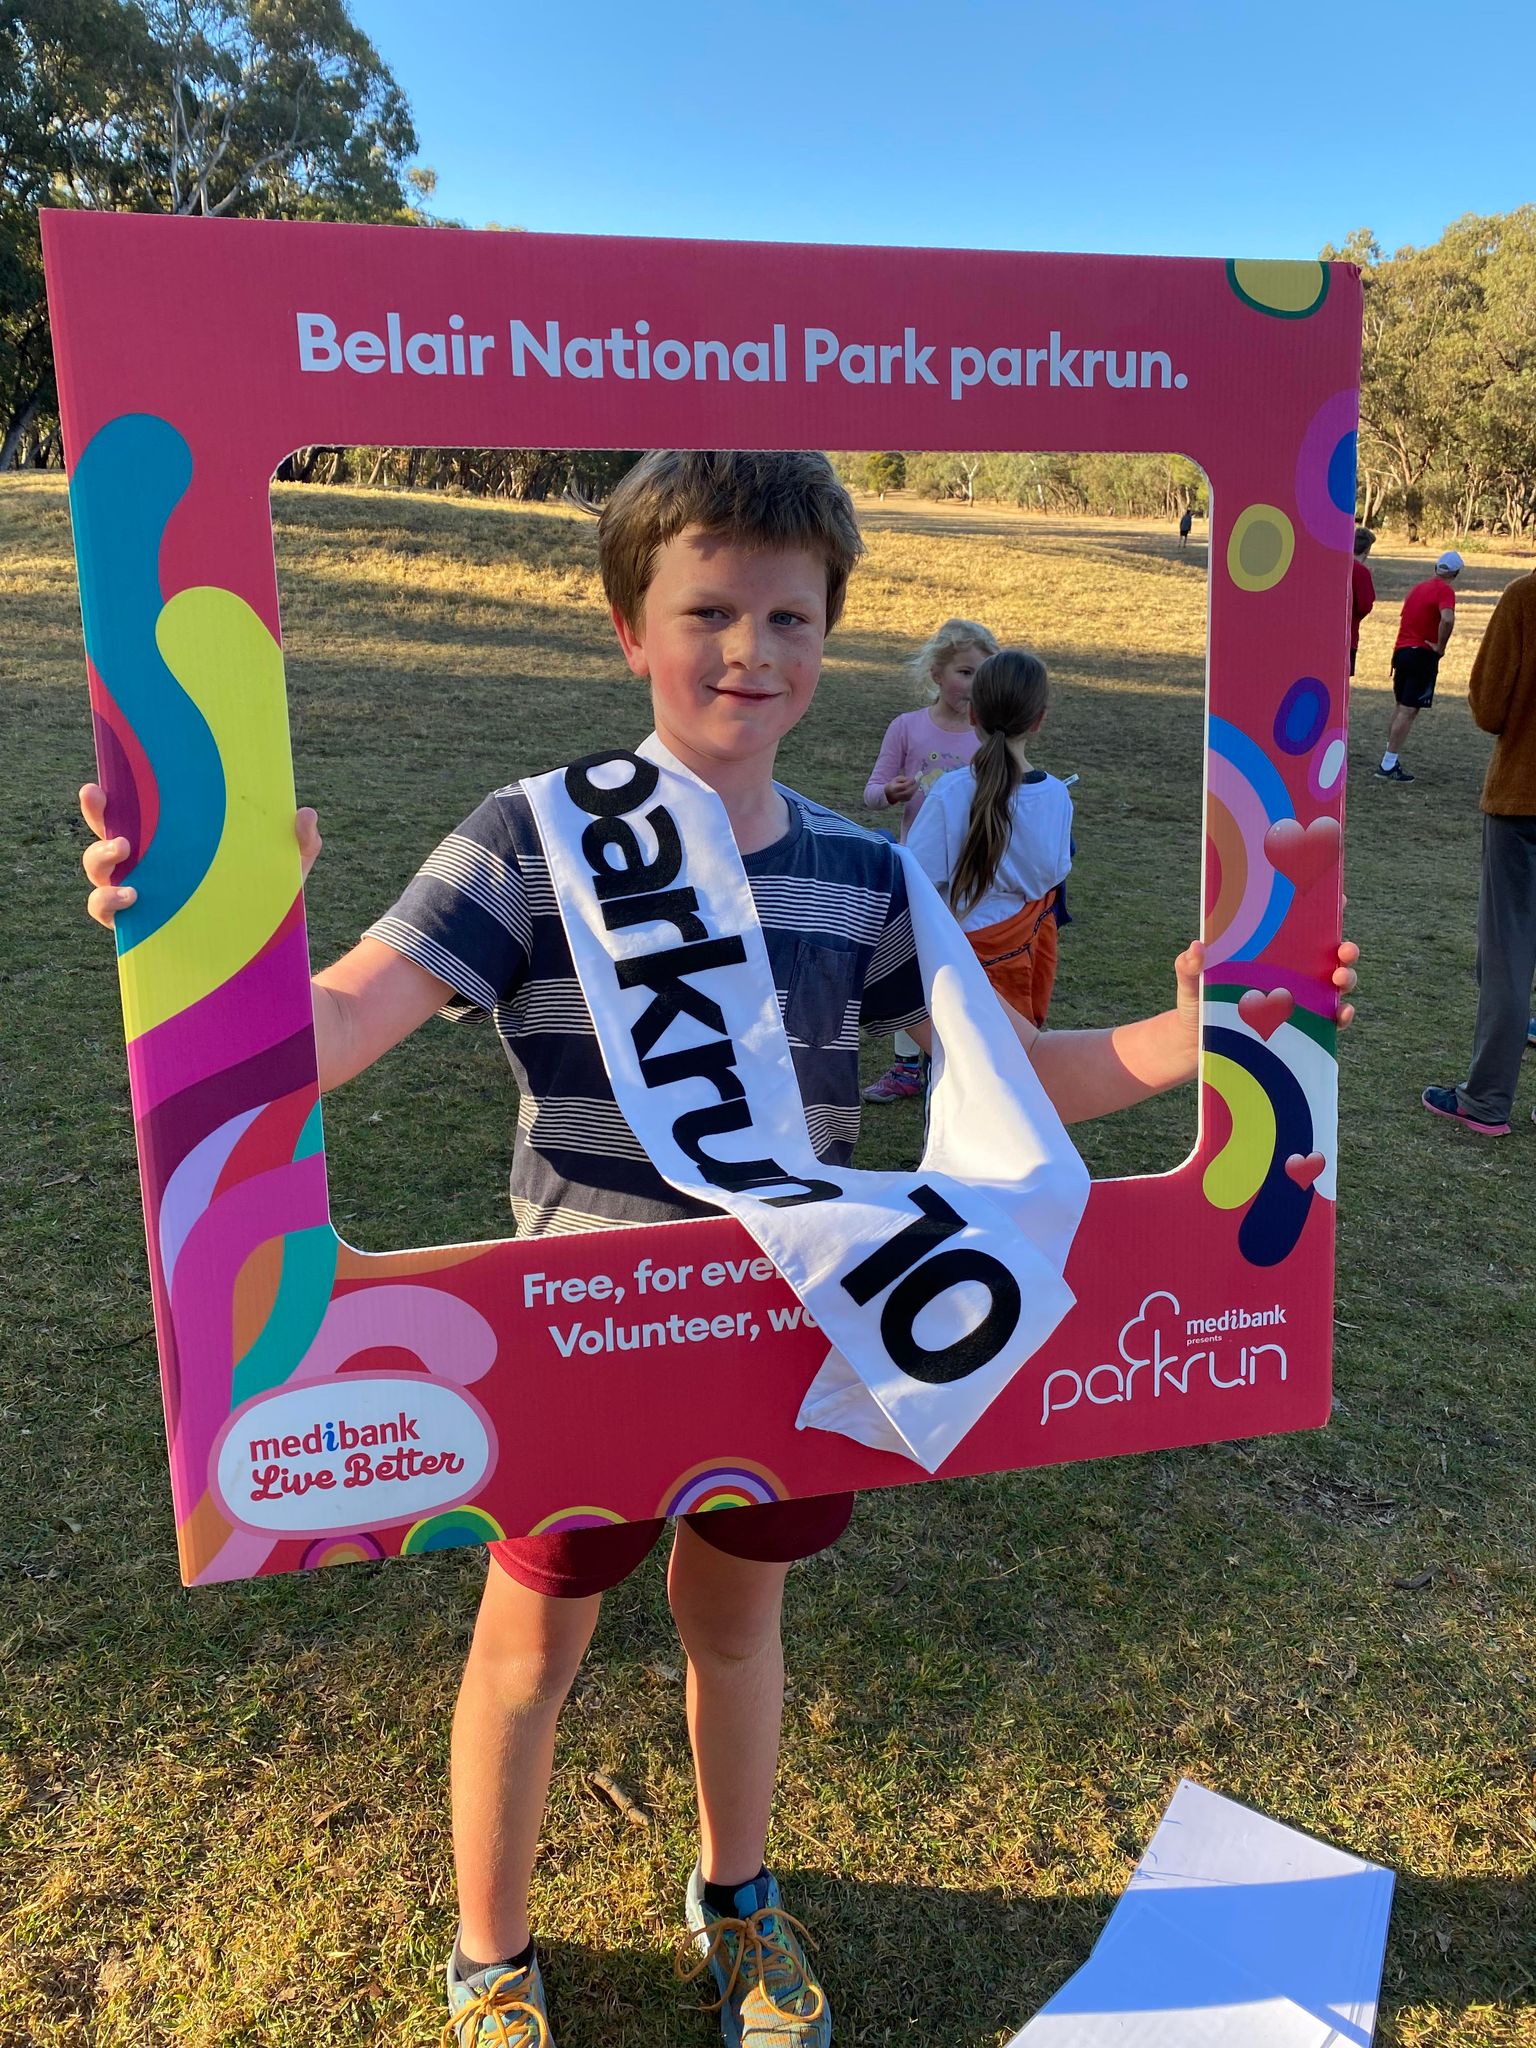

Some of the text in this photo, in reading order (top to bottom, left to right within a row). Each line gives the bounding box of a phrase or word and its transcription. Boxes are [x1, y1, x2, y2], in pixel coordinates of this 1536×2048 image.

[296, 312, 1188, 400] Belair National Park parkrun.
[523, 1272, 625, 1307] Free,
[633, 1259, 694, 1294] for
[840, 1184, 1021, 1384] 10
[548, 1311, 760, 1358] Volunteer,
[1186, 1304, 1287, 1335] medibank
[1186, 1334, 1223, 1347] presents
[1040, 1290, 1287, 1425] parkrun
[249, 1412, 421, 1462] medibank
[250, 1446, 464, 1501] Live Better
